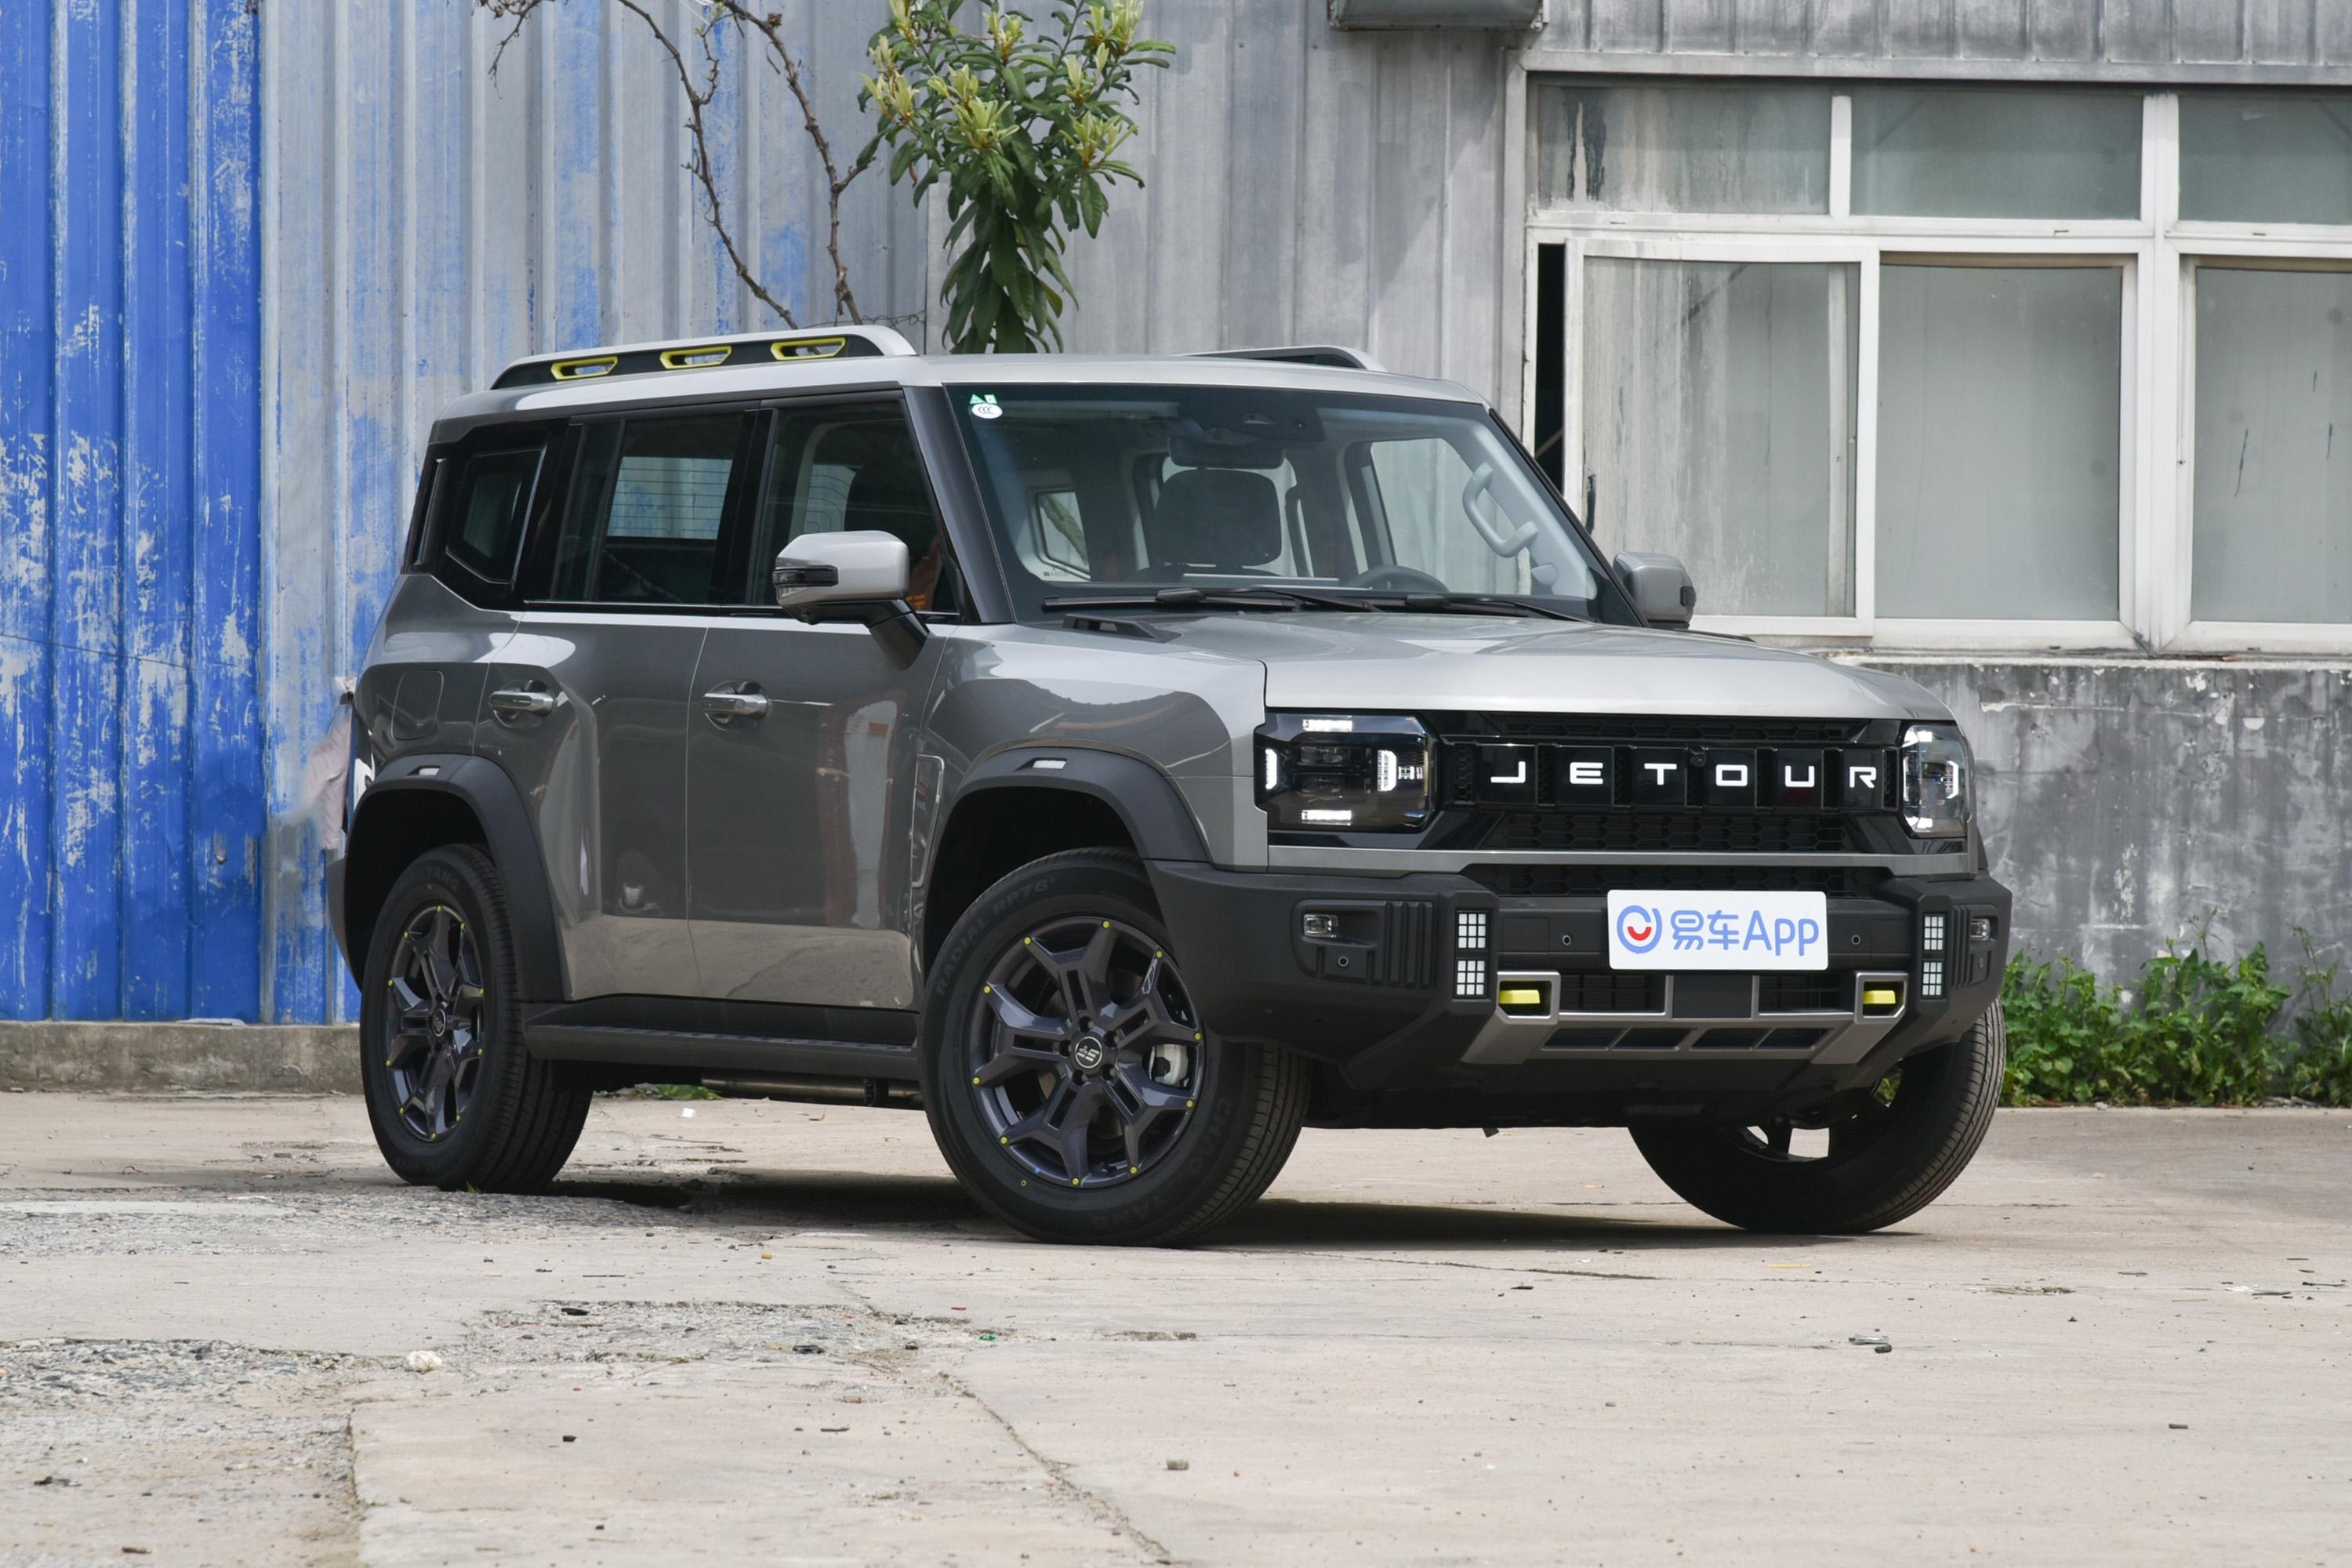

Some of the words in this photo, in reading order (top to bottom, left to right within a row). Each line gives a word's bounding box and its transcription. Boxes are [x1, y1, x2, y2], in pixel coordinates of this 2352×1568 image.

[1490, 760, 1877, 789] JETOUR
[1670, 909, 1820, 956] 易车App
[936, 917, 989, 996] RADIAL
